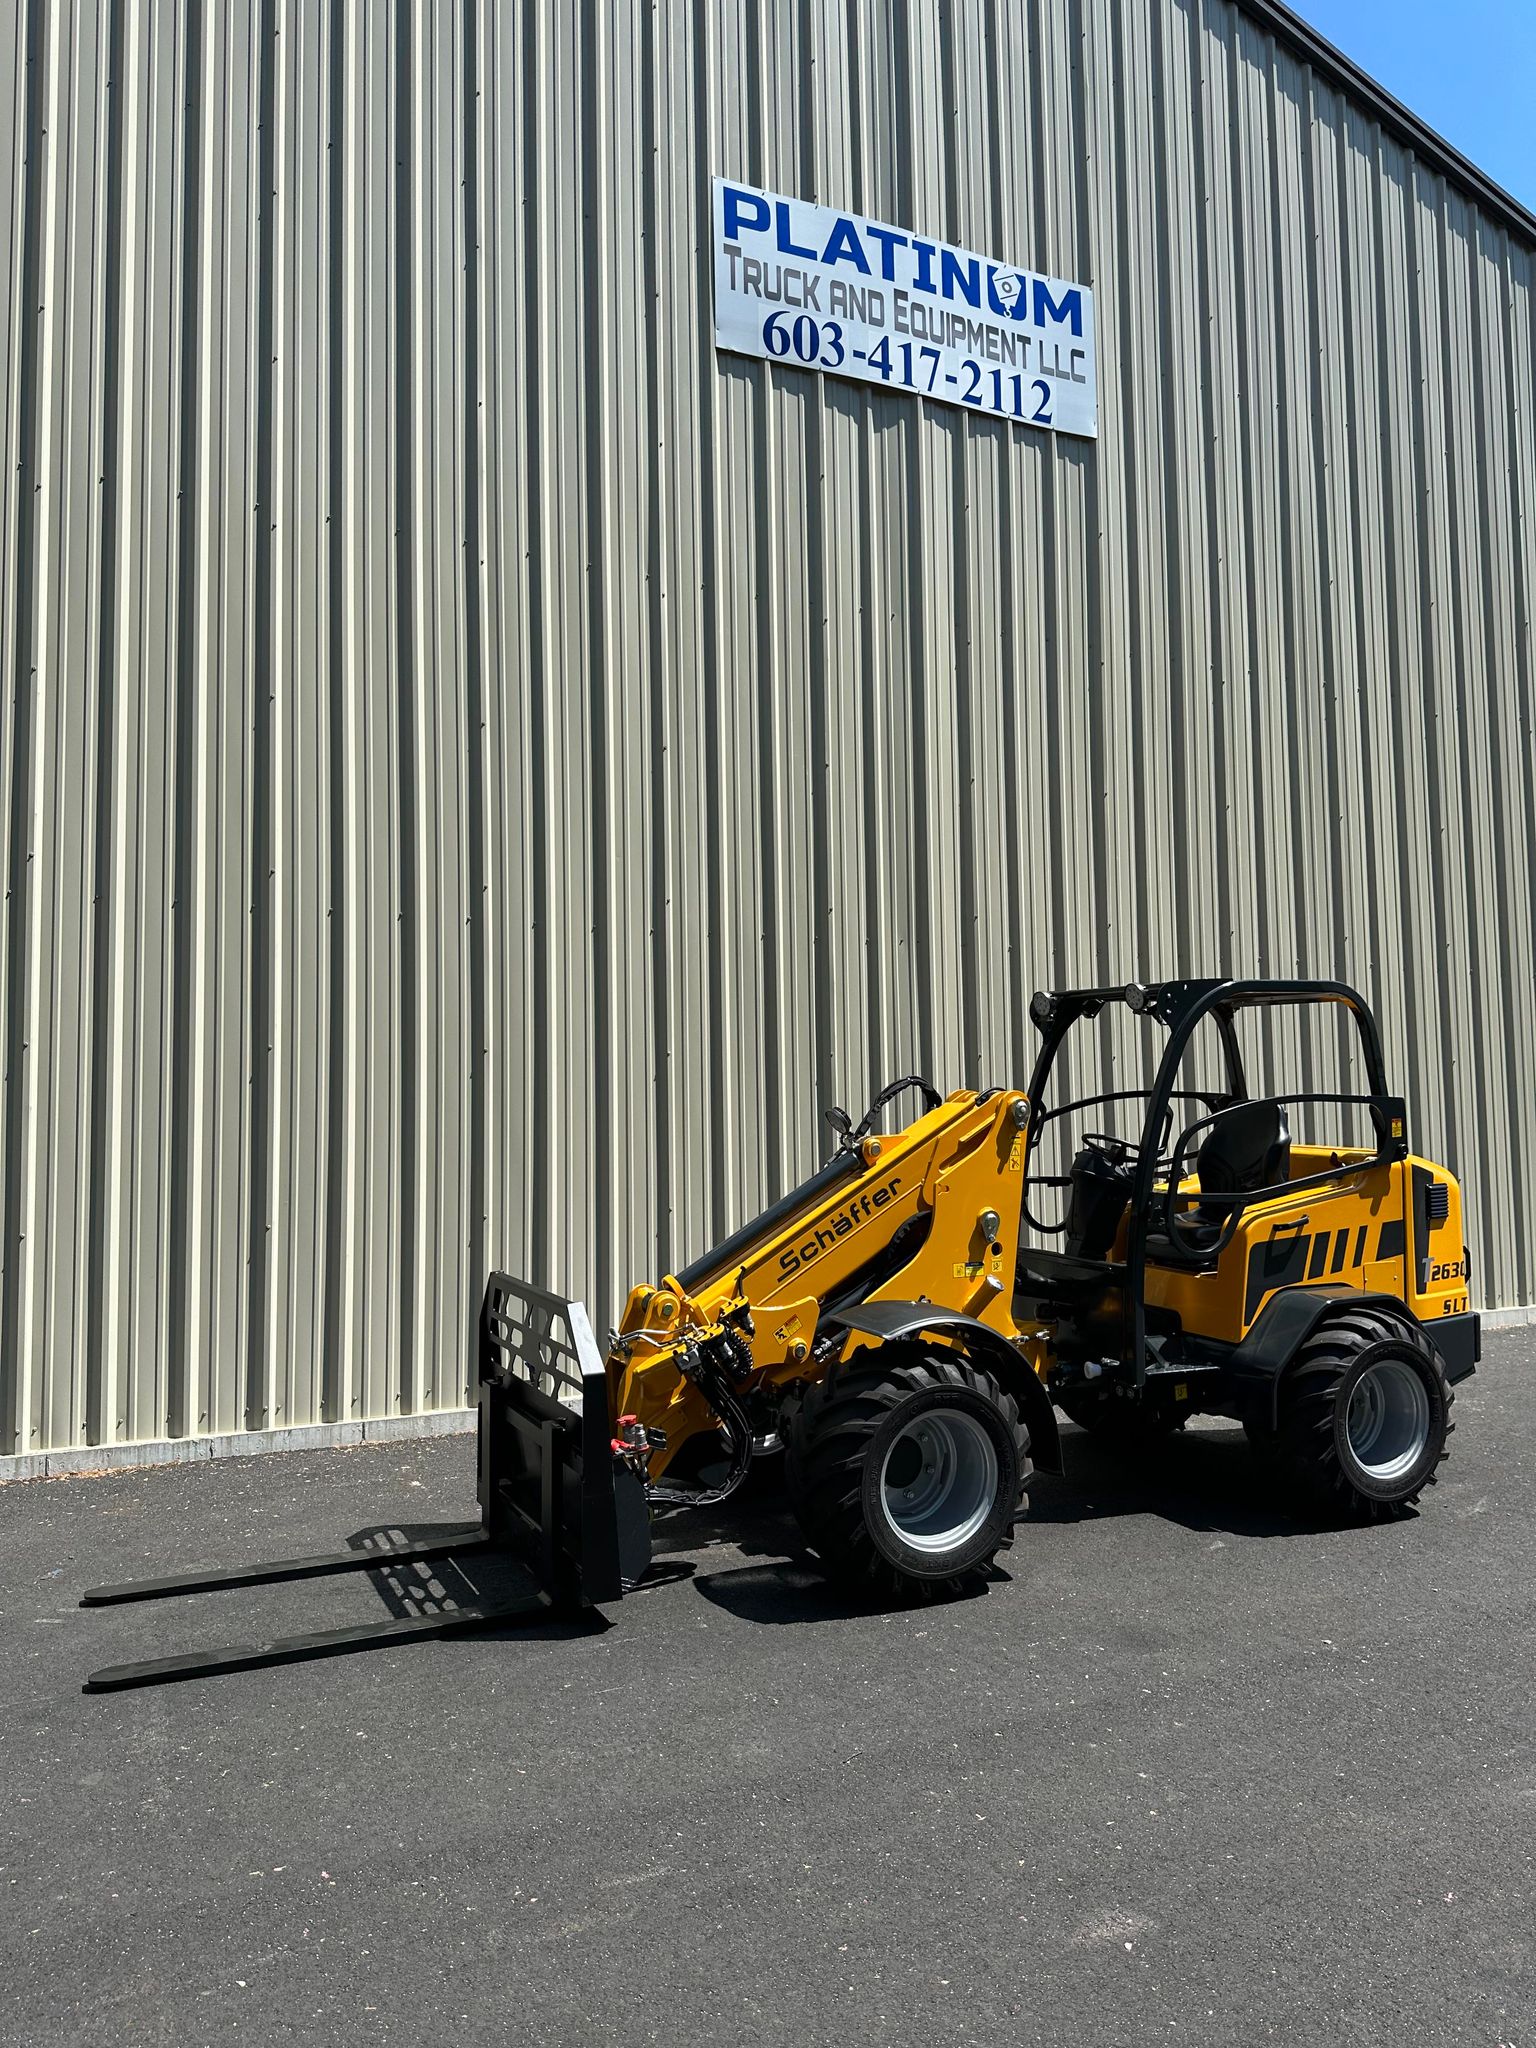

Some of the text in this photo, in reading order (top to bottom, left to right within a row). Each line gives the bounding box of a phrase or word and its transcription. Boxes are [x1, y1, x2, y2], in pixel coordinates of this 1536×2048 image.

[723, 186, 1083, 337] PLATINUM
[723, 243, 1086, 383] TRUCK AND EQUIPMENT LLC
[763, 310, 1053, 424] 603-417-2112
[777, 1177, 902, 1283] Schäffer
[1443, 1296, 1468, 1315] SLT
